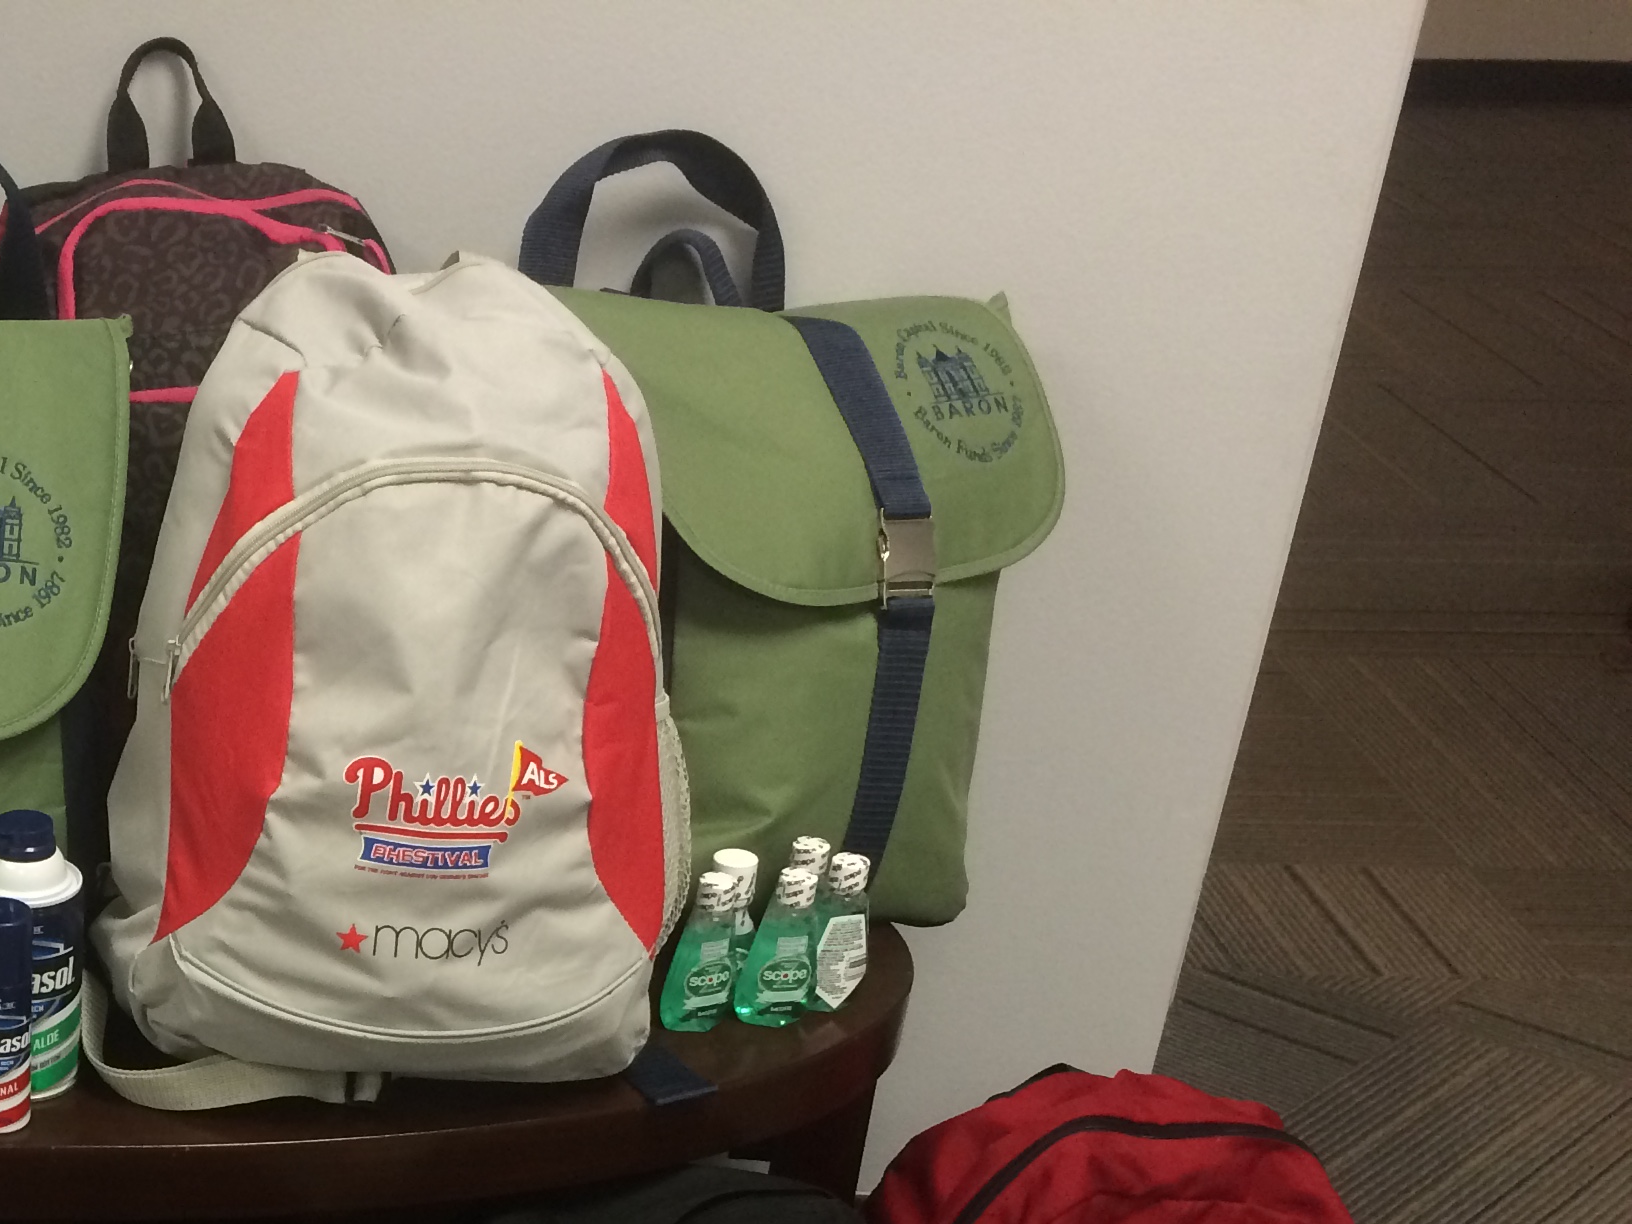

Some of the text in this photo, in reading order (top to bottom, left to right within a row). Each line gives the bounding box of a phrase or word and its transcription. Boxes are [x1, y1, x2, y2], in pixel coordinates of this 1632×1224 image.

[931, 396, 1010, 422] BARON
[913, 404, 953, 449] Baron
[9, 462, 52, 505] Since
[47, 504, 73, 550] 1982
[32, 570, 67, 609] 1987
[343, 755, 522, 828] Phillies
[521, 761, 559, 790] ALS
[371, 843, 484, 867] PHESTIVAL
[31, 955, 74, 995] asol
[689, 970, 730, 987] scope
[762, 968, 807, 985] scope
